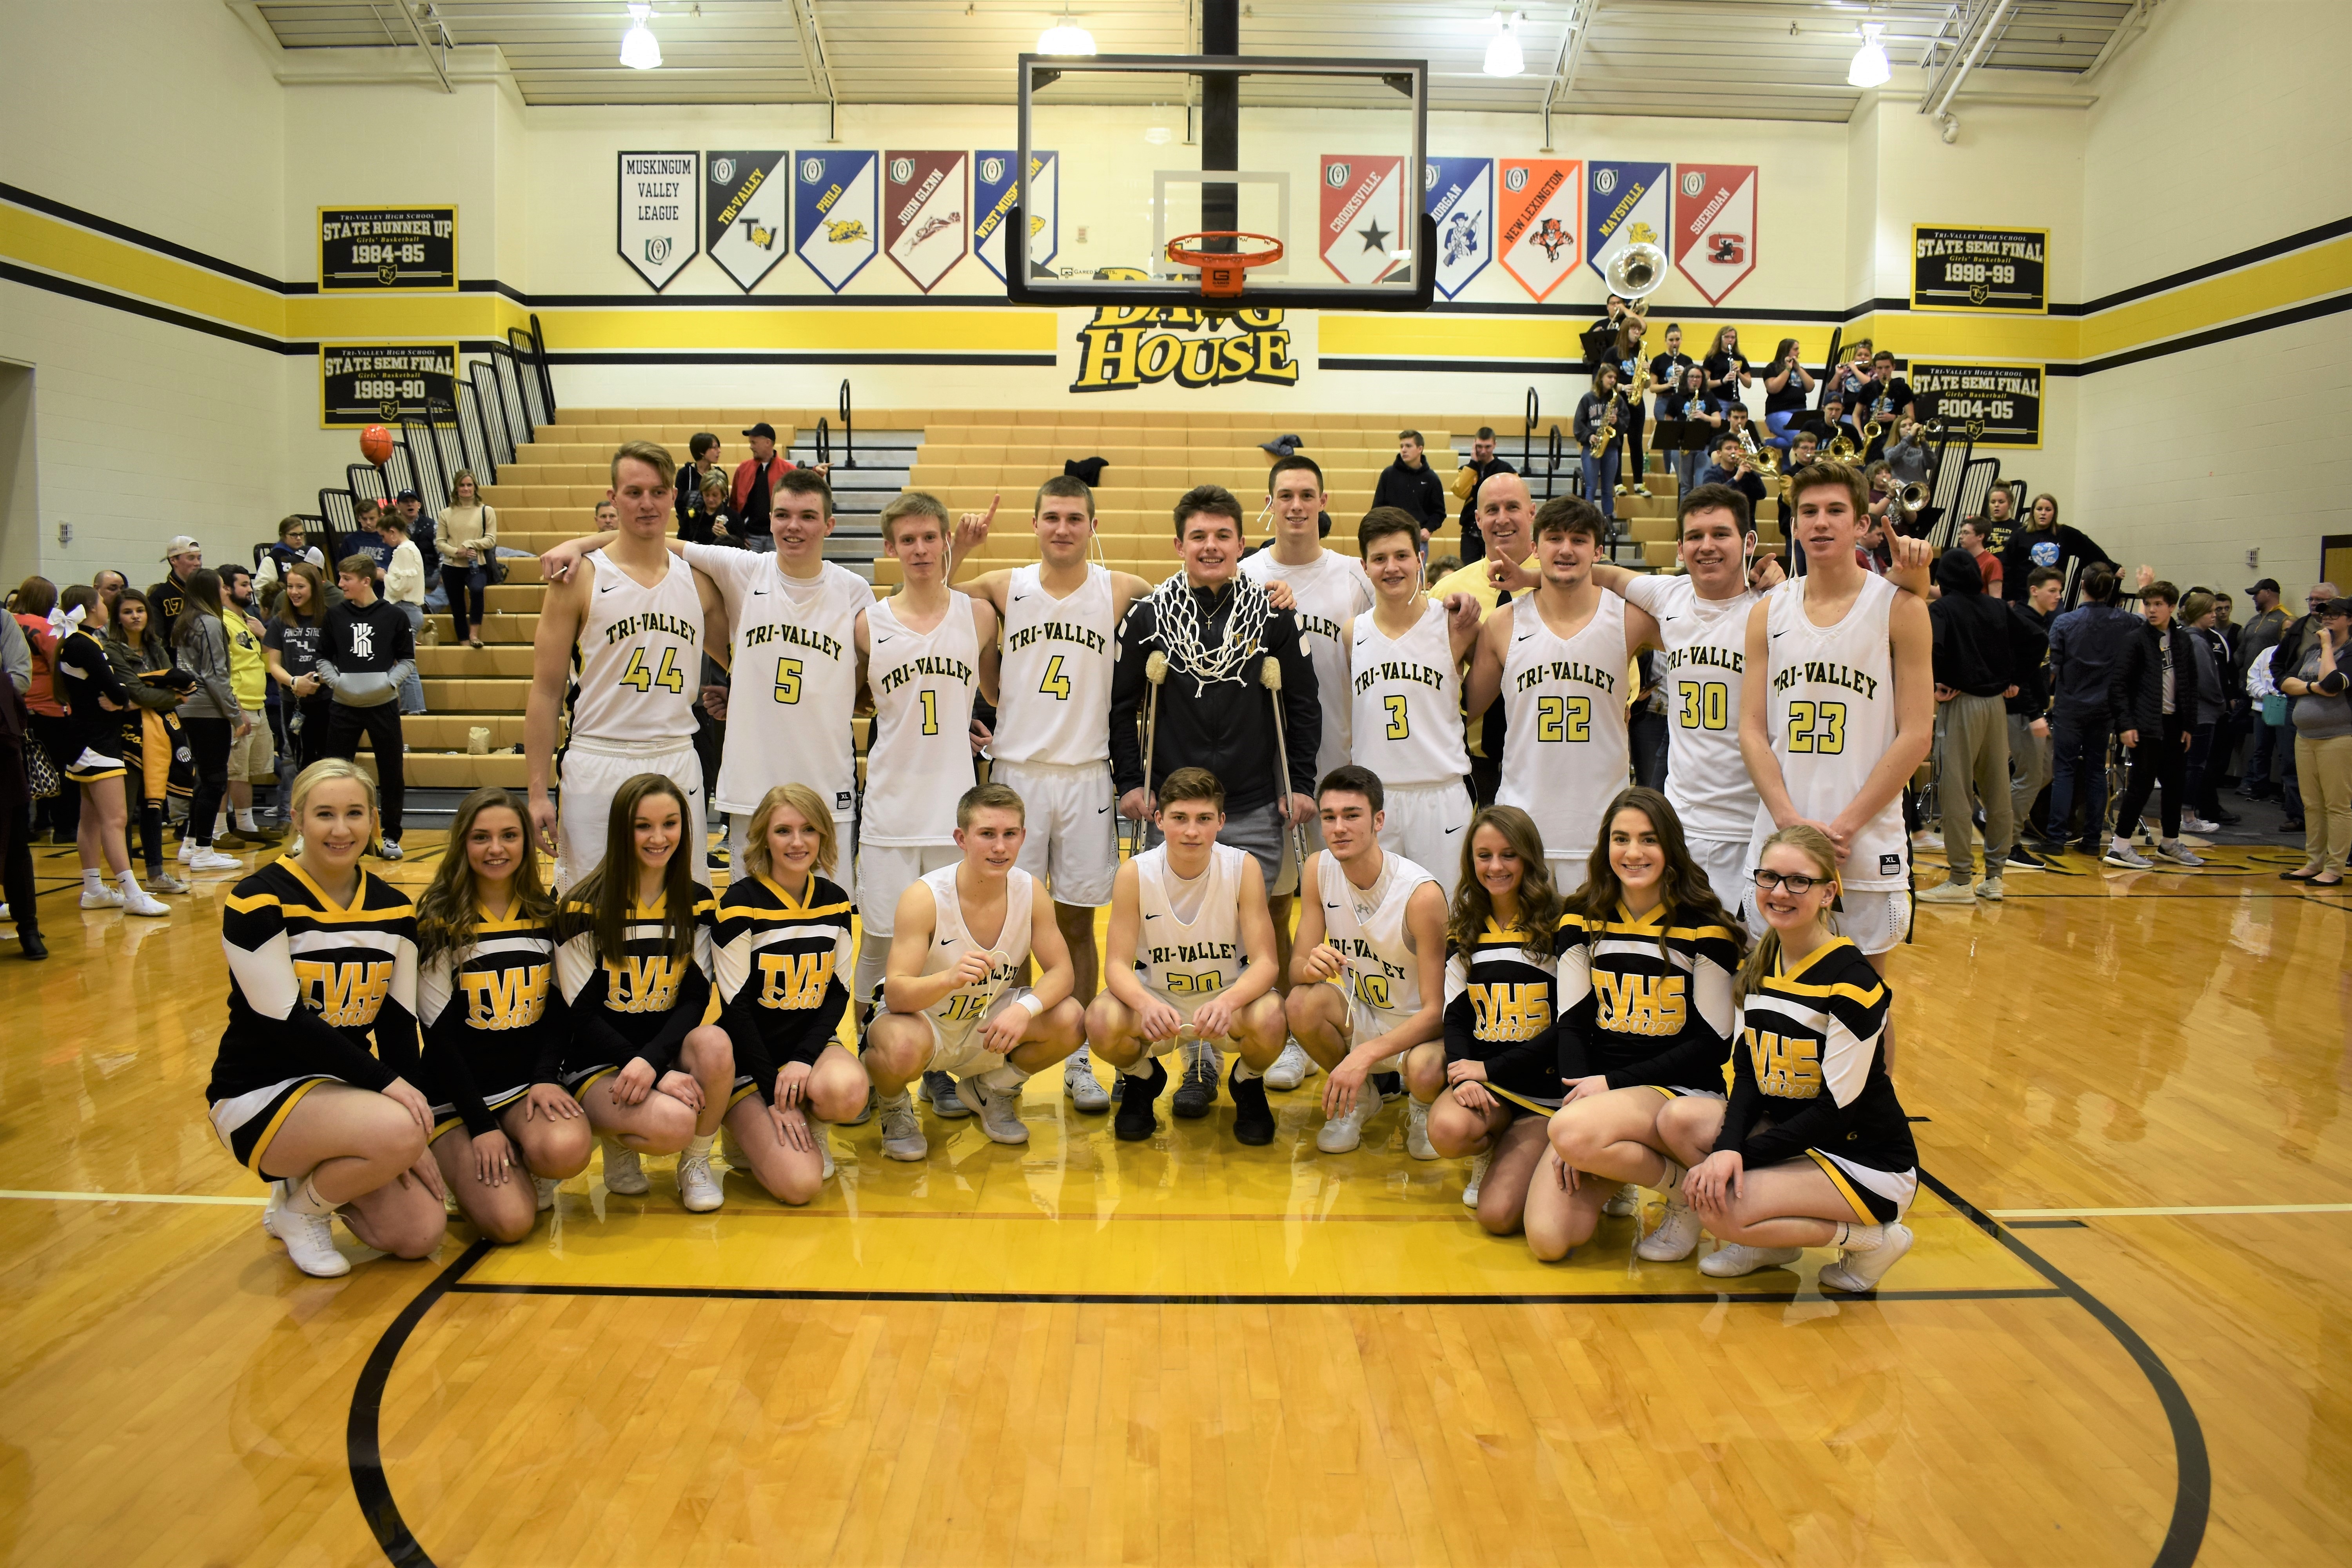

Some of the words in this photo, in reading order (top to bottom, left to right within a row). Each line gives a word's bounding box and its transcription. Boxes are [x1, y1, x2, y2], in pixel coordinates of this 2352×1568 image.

[627, 160, 691, 174] MUSKINGUM
[638, 183, 679, 197] VALLEY
[718, 167, 765, 226] TRI-VALLEY
[816, 183, 842, 214] PHILO
[897, 197, 922, 226] JOHN
[915, 168, 944, 200] GLENN
[1330, 171, 1382, 234] CROOKSVILLE
[1504, 217, 1525, 243] NEW
[1523, 169, 1564, 221] LEXINGTON
[638, 206, 679, 220] LEAGUE
[975, 209, 1001, 239] WEST
[1599, 182, 1645, 237] MAYSVILLE
[1690, 187, 1731, 235] SHERIDAN
[323, 221, 371, 241] STATE
[372, 220, 431, 235] RUNNER
[434, 220, 453, 239] UP
[352, 244, 425, 263] 1984-85
[1917, 238, 1964, 258] STATE
[1965, 240, 2000, 255] SEMI
[2002, 241, 2043, 263] FINAL
[1945, 263, 2015, 284] 1998-99
[325, 357, 372, 377] STATE
[374, 357, 408, 370] SEMI
[410, 356, 454, 376] FINAL
[1069, 328, 1298, 393] HOUSE
[354, 380, 425, 399] 1989-90
[1913, 374, 1960, 394] STATE
[1961, 376, 1996, 390] SEMI
[1998, 377, 2039, 399] FINAL
[1938, 399, 2014, 419] 2004-05
[163, 597, 184, 617] 17
[606, 612, 695, 646] TRI-VALLEY
[746, 624, 842, 661] TRI-VALLEY
[1009, 622, 1105, 655] TRI-VALLEY
[619, 646, 683, 694] 44
[881, 656, 972, 694] TRI-VALLEY
[1039, 655, 1071, 700] 4
[1355, 661, 1443, 696] TRI-VALLEY
[1517, 661, 1615, 694] TRI-VALLEY
[1667, 646, 1746, 674] TRI-VALLE
[774, 657, 803, 705] 5
[1774, 662, 1877, 700] TRI-VALLEY
[920, 690, 938, 735] 1
[1384, 695, 1409, 740] 3
[1537, 696, 1591, 742] 22
[1679, 681, 1728, 730] 30
[1788, 701, 1847, 755] 23
[293, 959, 393, 1015] TVHS
[1348, 967, 1394, 1009] 10
[1591, 967, 1686, 1022] TVHS
[1467, 982, 1552, 1030] TVHS
[1595, 1003, 1684, 1036] Scotties
